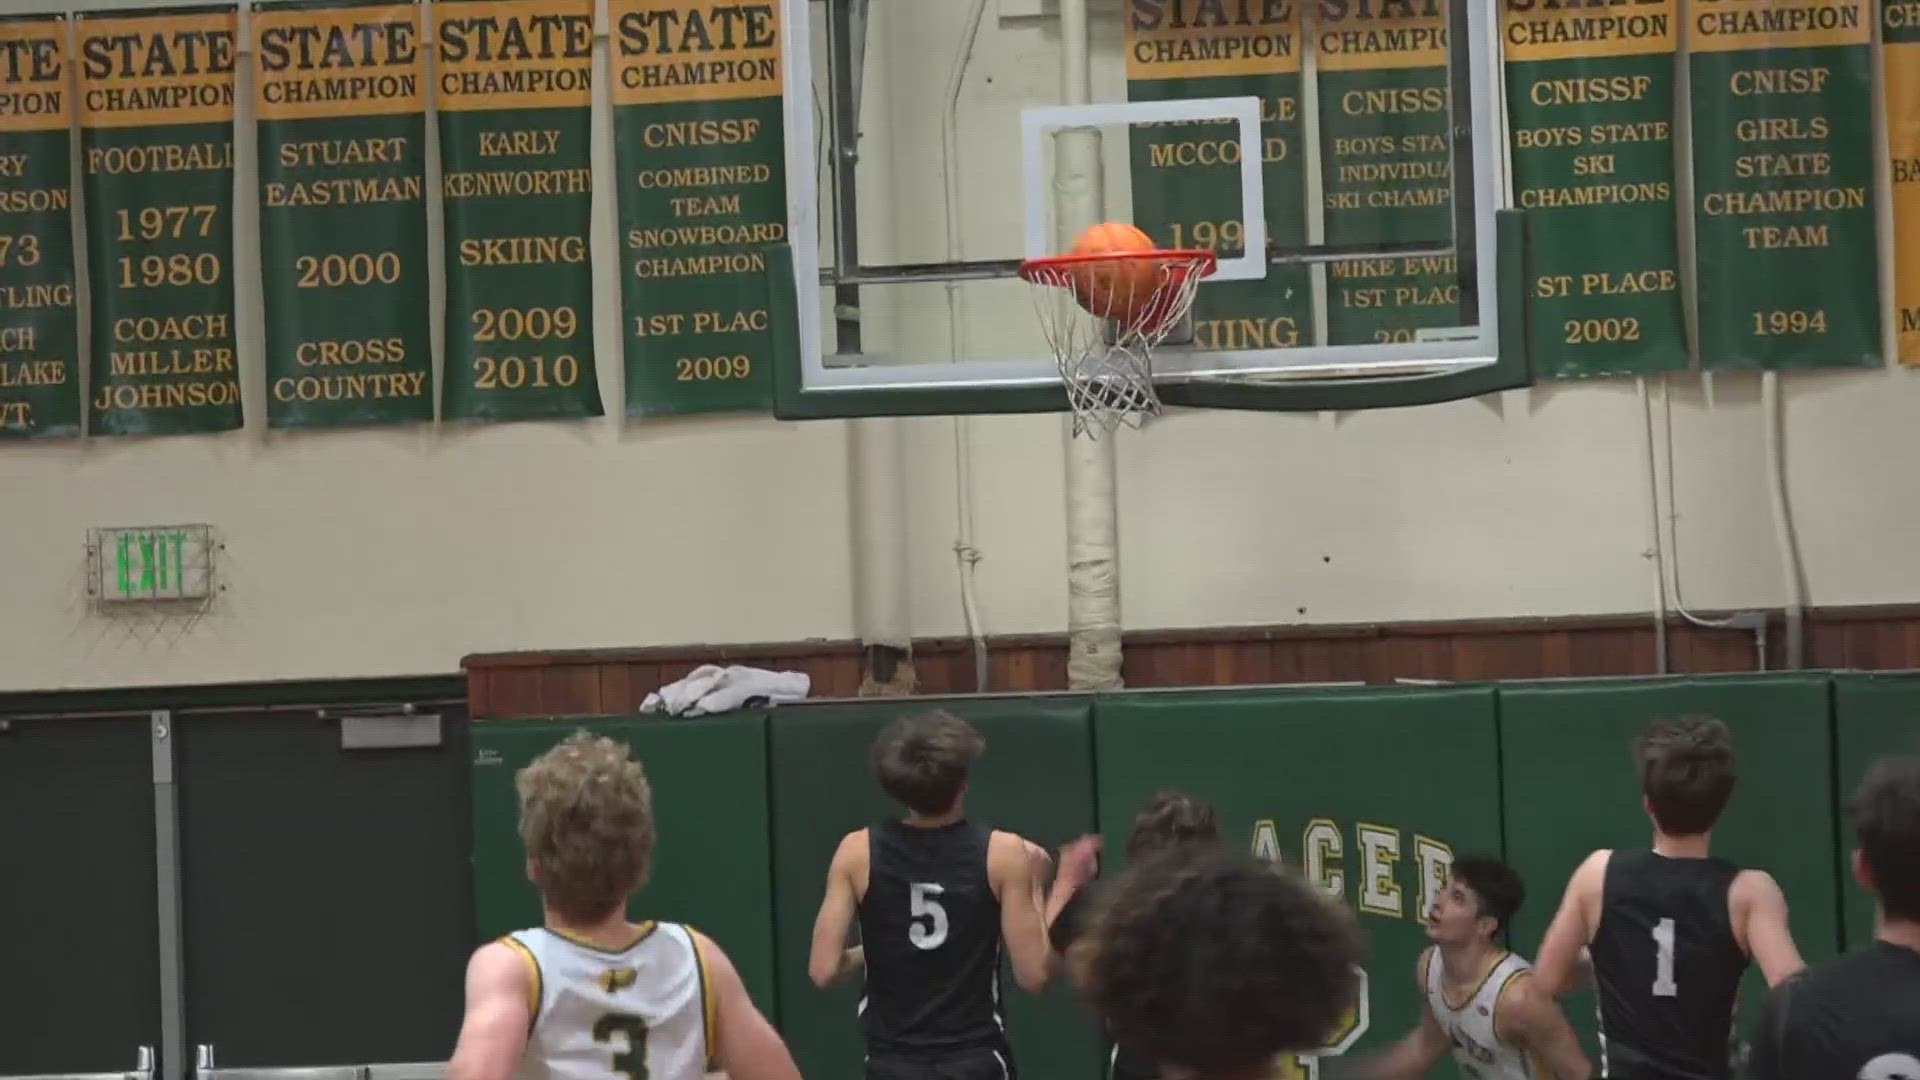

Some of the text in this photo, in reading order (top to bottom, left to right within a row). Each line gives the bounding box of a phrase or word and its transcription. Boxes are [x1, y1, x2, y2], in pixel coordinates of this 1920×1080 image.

[618, 4, 776, 56] STATE
[1508, 14, 1668, 45] CHAMPION
[1697, 5, 1859, 36] CHAMPION
[260, 21, 416, 73] STATE
[440, 15, 591, 64] STATE
[1134, 33, 1292, 64] CHAMPION
[82, 31, 234, 81] STATE
[441, 67, 591, 96] CHAMPION
[620, 58, 776, 90] CHAMPION
[1729, 68, 1830, 96] CNISF
[85, 82, 234, 113] CHAMPION
[262, 74, 417, 105] CHAMPION
[1341, 87, 1449, 116] CNISS
[1530, 76, 1652, 106] CNISSF
[479, 130, 561, 157] KARLY
[643, 118, 760, 149] CNISSF
[1516, 121, 1669, 149] BOYS STATE
[1735, 116, 1829, 143] GIRLS
[279, 137, 407, 168] STUART
[1149, 137, 1288, 168] MCCOD
[1335, 136, 1395, 156] BOYS
[638, 163, 770, 190] COMBINED
[1572, 154, 1615, 176] SKI
[1735, 152, 1832, 179] STATE
[265, 176, 422, 208] EASTMAN
[671, 194, 740, 218] TEAM
[1326, 192, 1360, 209] SKI
[1520, 181, 1670, 209] CHAMPIONS
[1703, 187, 1865, 216] CHAMPION
[116, 205, 218, 241] 1977
[628, 222, 785, 249] SNOWBOARD
[1169, 220, 1273, 251] 199
[1742, 225, 1829, 250] TEAM
[460, 236, 586, 268] SKIING
[118, 253, 220, 289] 1980
[295, 251, 401, 288] 2000
[1332, 258, 1394, 278] MIKE
[0, 284, 72, 308] LING
[1343, 288, 1387, 308] 1ST
[1531, 270, 1676, 298] ST PLACE
[113, 314, 228, 343] COACH
[471, 306, 577, 342] 2009
[634, 310, 768, 337] 1ST PLAC
[1193, 316, 1299, 350] KIING
[1564, 317, 1640, 345] 2002
[1752, 309, 1828, 336] 1994
[0, 326, 34, 352] CH
[295, 337, 405, 367] CROSS
[110, 349, 233, 376] MILLER
[473, 355, 578, 391] 2010
[676, 355, 751, 382] 2009
[273, 371, 426, 403] COUNTRY
[115, 533, 187, 592] EXIT
[907, 882, 950, 951] 5
[1652, 916, 1678, 997] 1
[591, 1012, 650, 1080] 3
